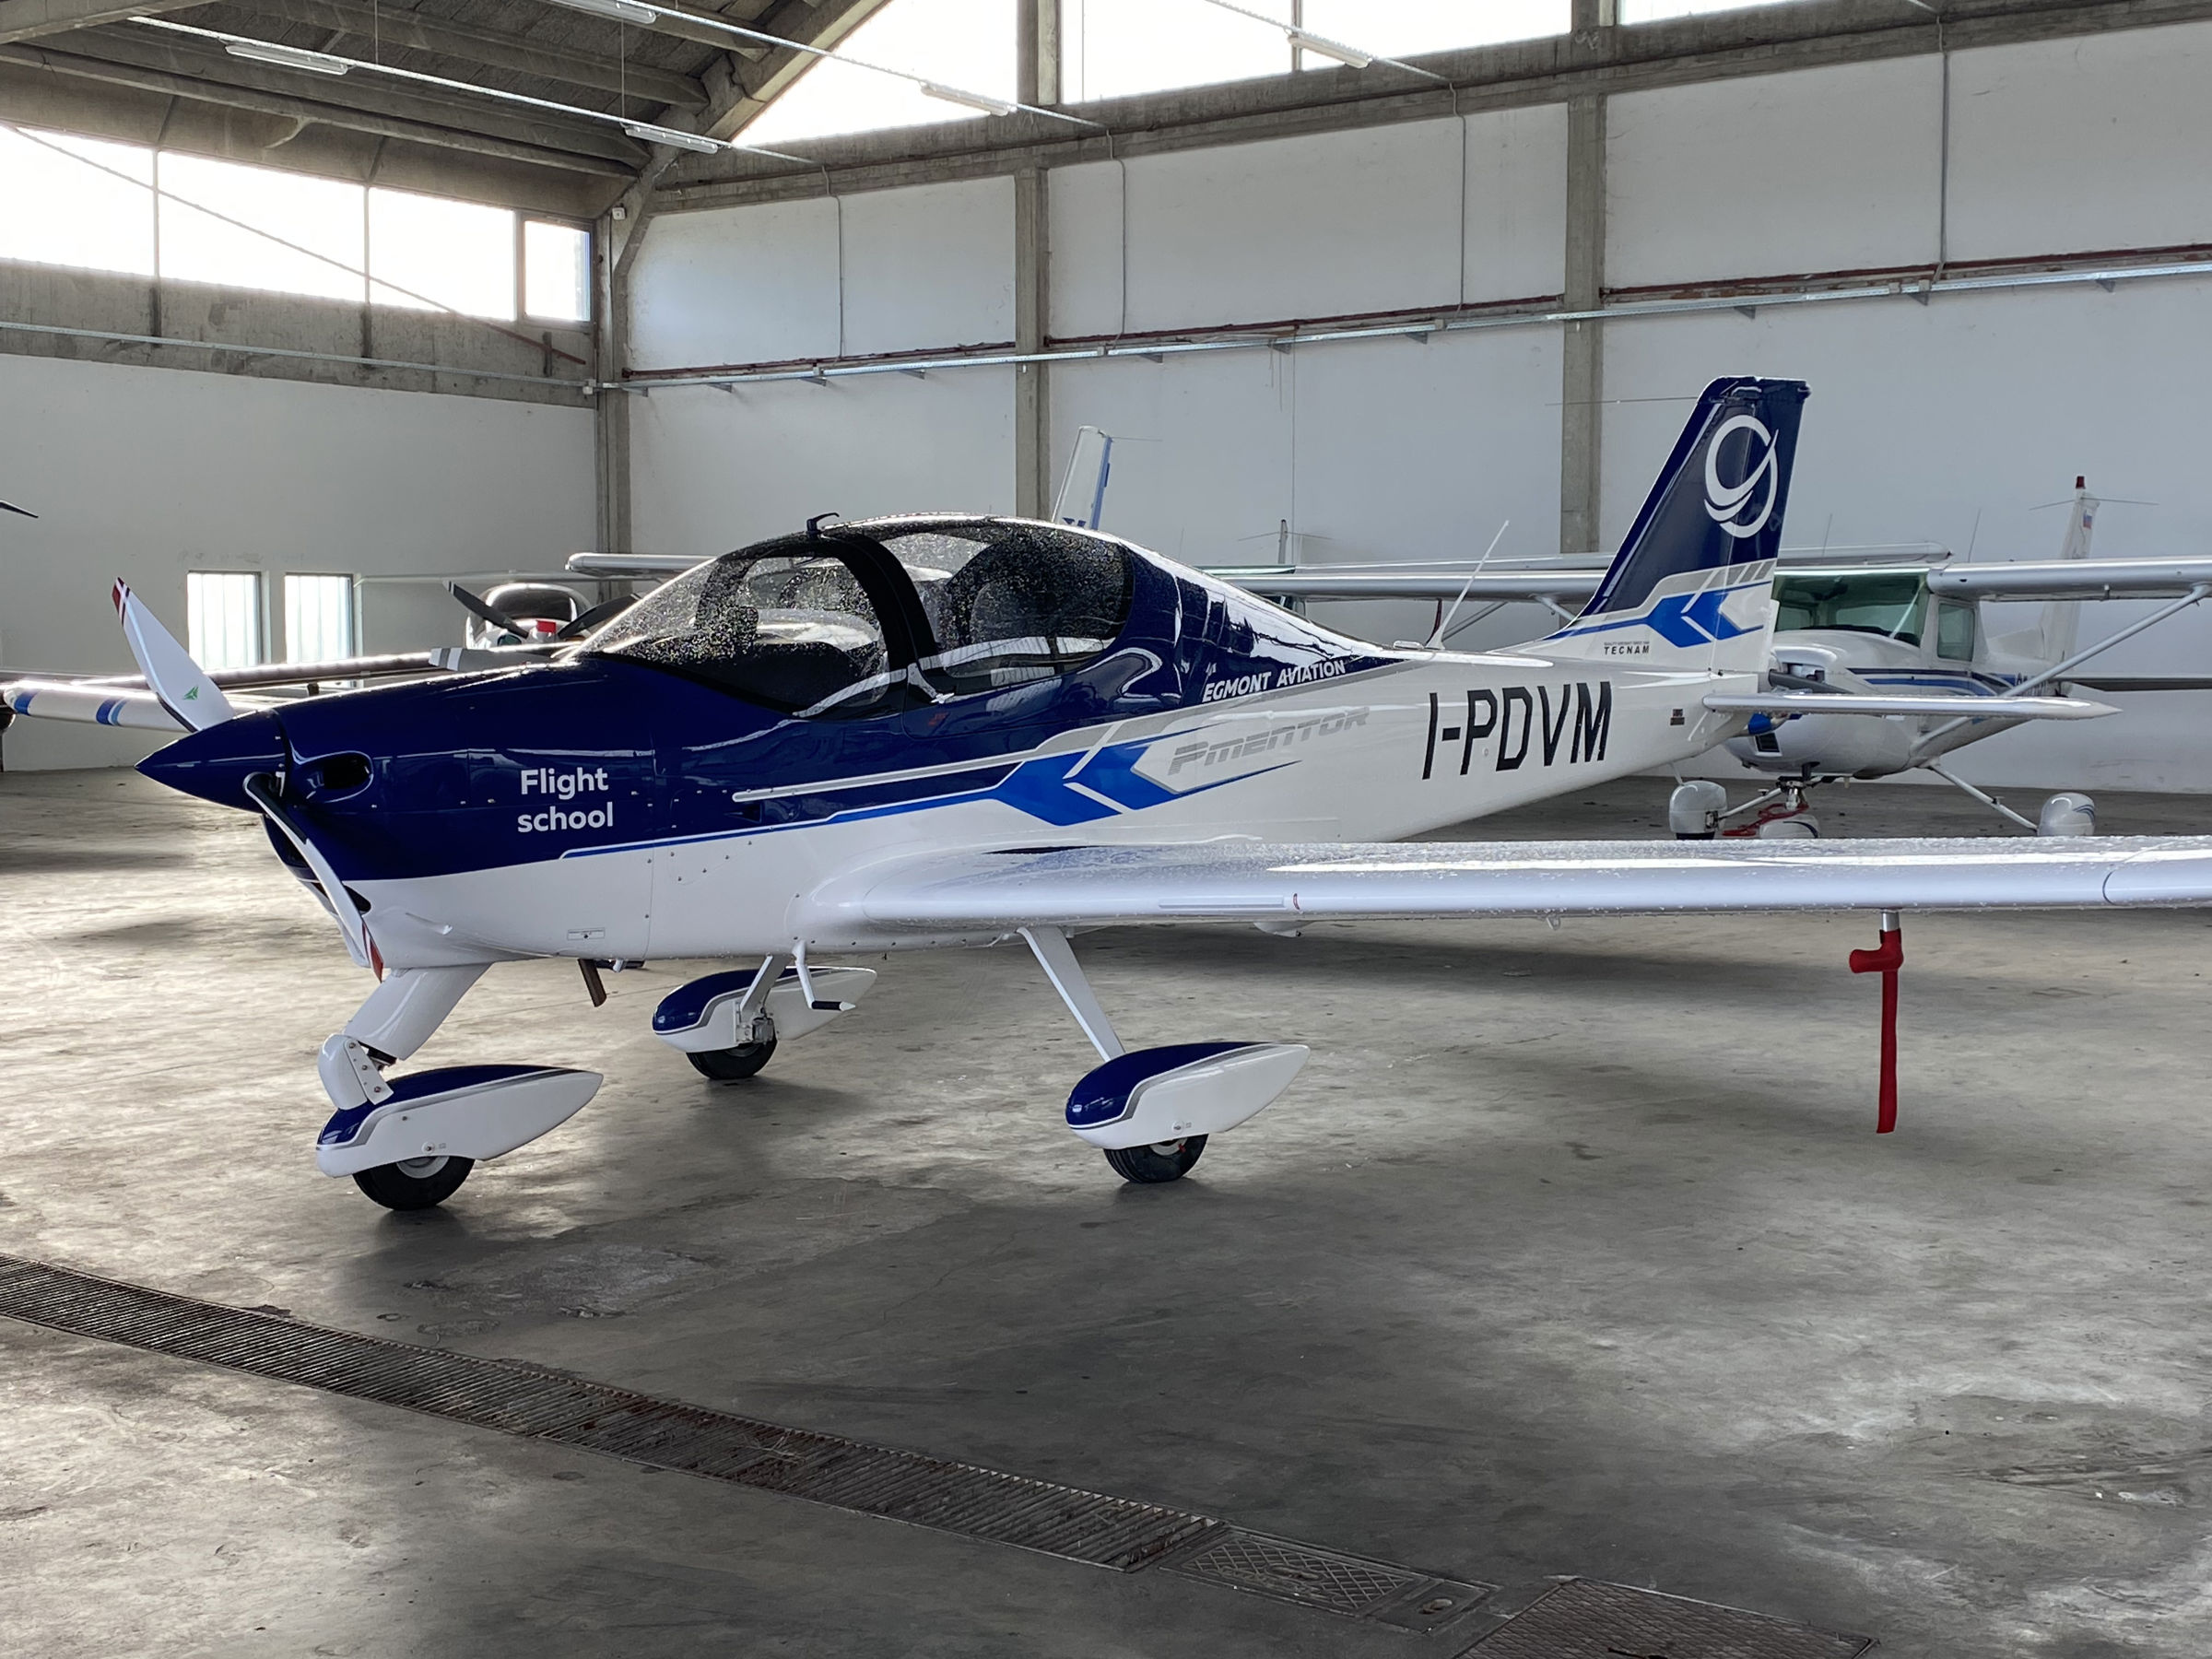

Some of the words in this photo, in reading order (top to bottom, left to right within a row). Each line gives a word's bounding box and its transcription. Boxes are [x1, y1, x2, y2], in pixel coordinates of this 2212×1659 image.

[1604, 645, 1650, 655] TECNAM
[1202, 672, 1272, 703] EGMONT
[1277, 659, 1346, 688] AVIATION
[1421, 680, 1613, 781] I-PDVM
[520, 767, 609, 800] Flight
[517, 801, 614, 833] school
